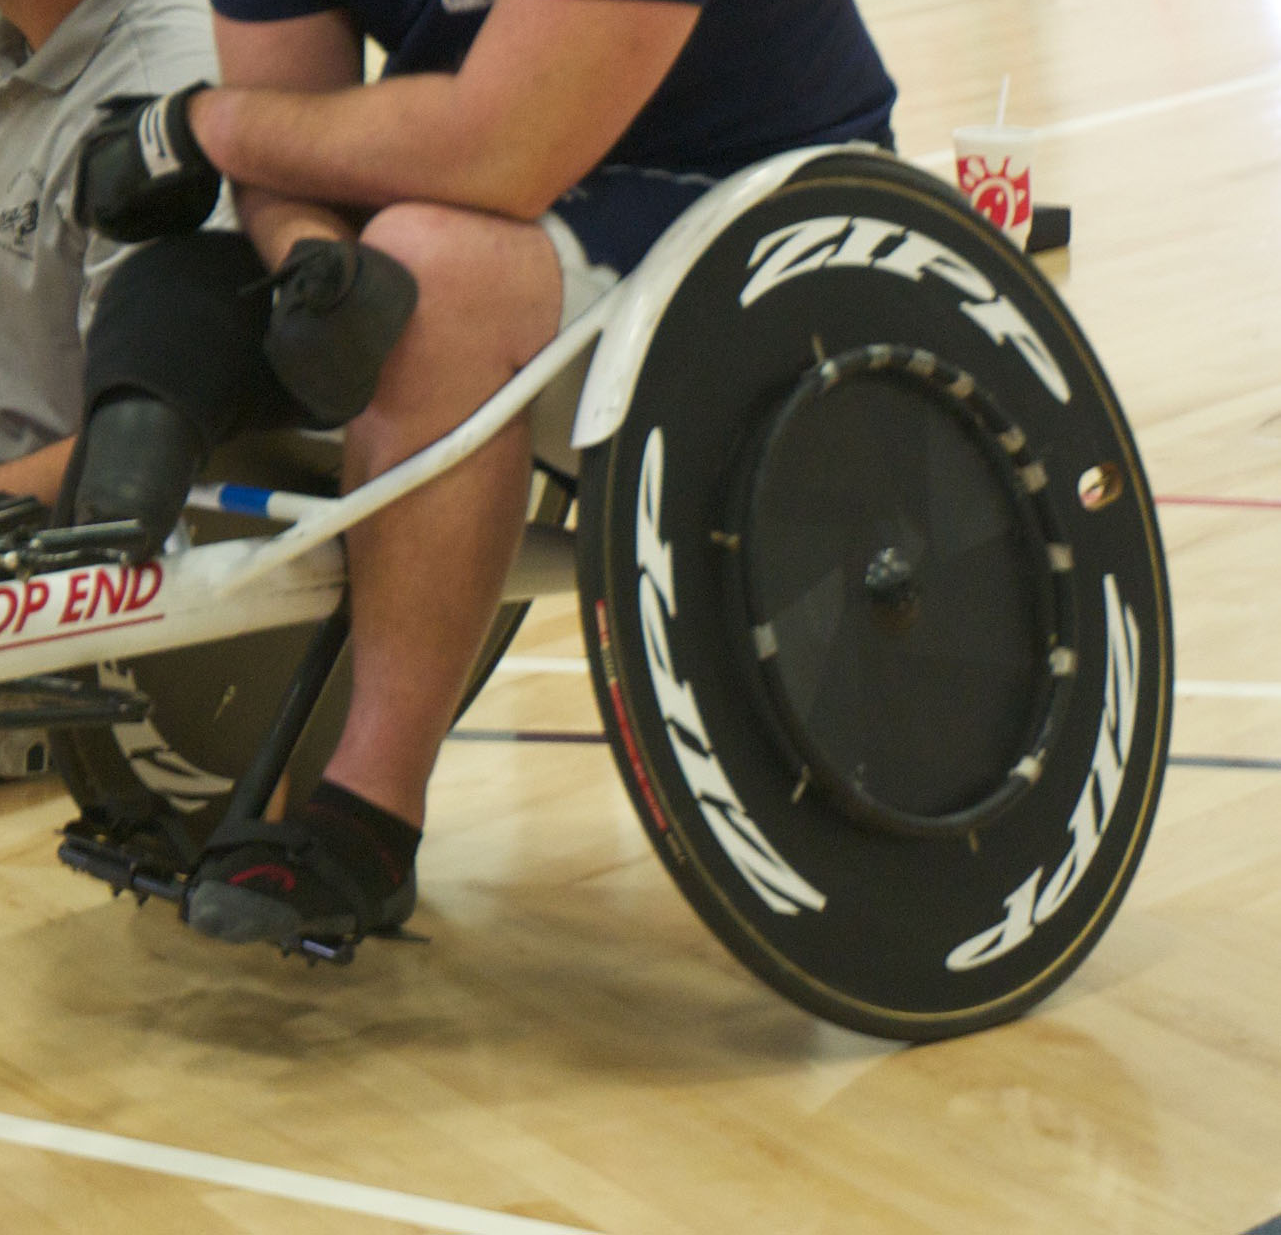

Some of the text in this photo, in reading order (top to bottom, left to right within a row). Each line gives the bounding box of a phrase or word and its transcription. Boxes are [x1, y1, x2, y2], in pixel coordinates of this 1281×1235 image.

[740, 215, 1071, 404] ZIPP
[58, 561, 164, 625] END
[637, 426, 827, 916] ZIPP
[945, 574, 1141, 972] ZIPP
